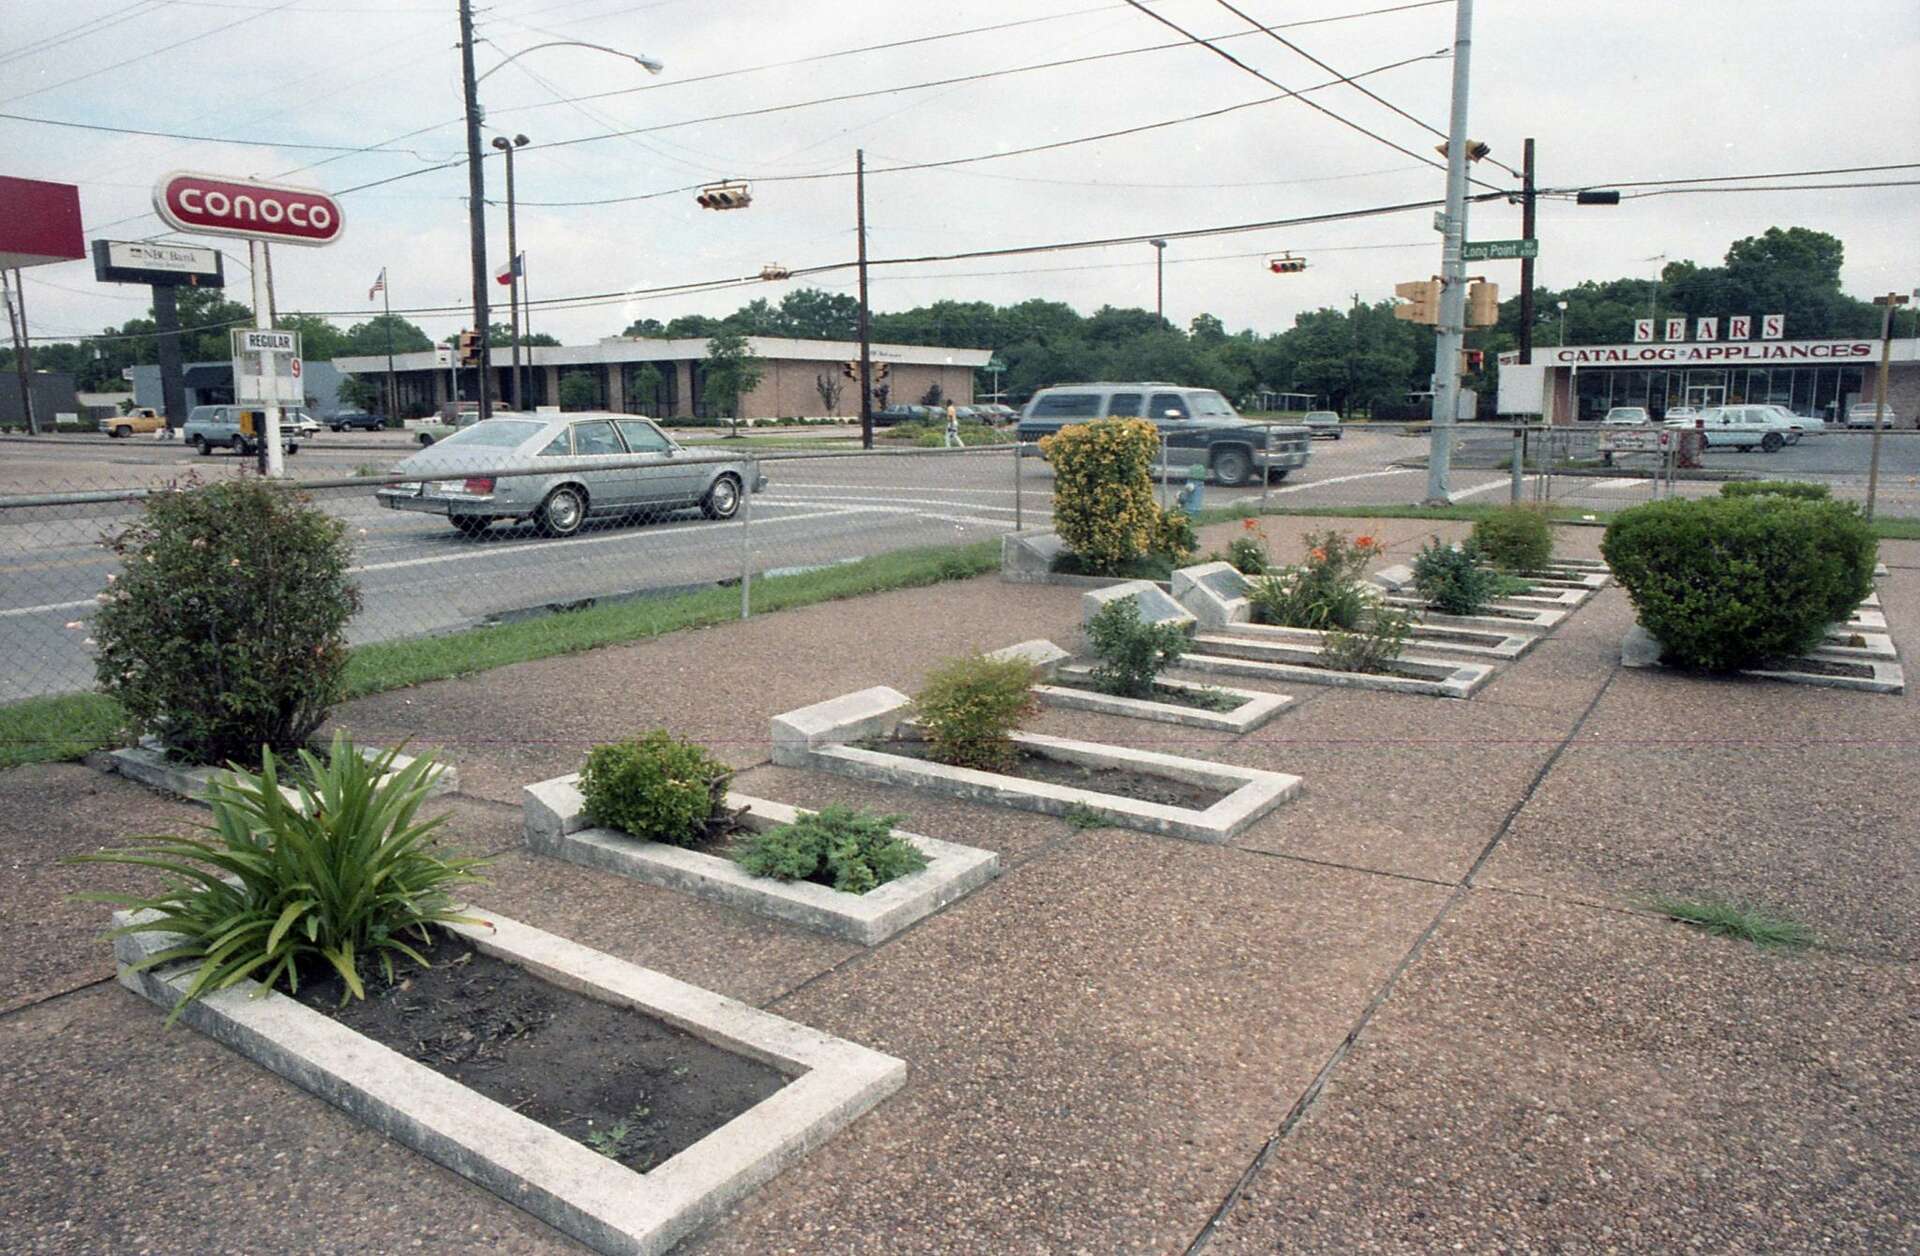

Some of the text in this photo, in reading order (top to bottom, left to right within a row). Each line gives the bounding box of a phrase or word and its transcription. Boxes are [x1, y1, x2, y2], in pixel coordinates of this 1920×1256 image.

[169, 250, 196, 261] Bank
[1464, 244, 1517, 259] Long Point
[1638, 317, 1780, 340] SEARS
[249, 334, 290, 348] REGULAR
[1558, 343, 1872, 362] CATALOG APPLIANCES
[292, 359, 300, 378] 9
